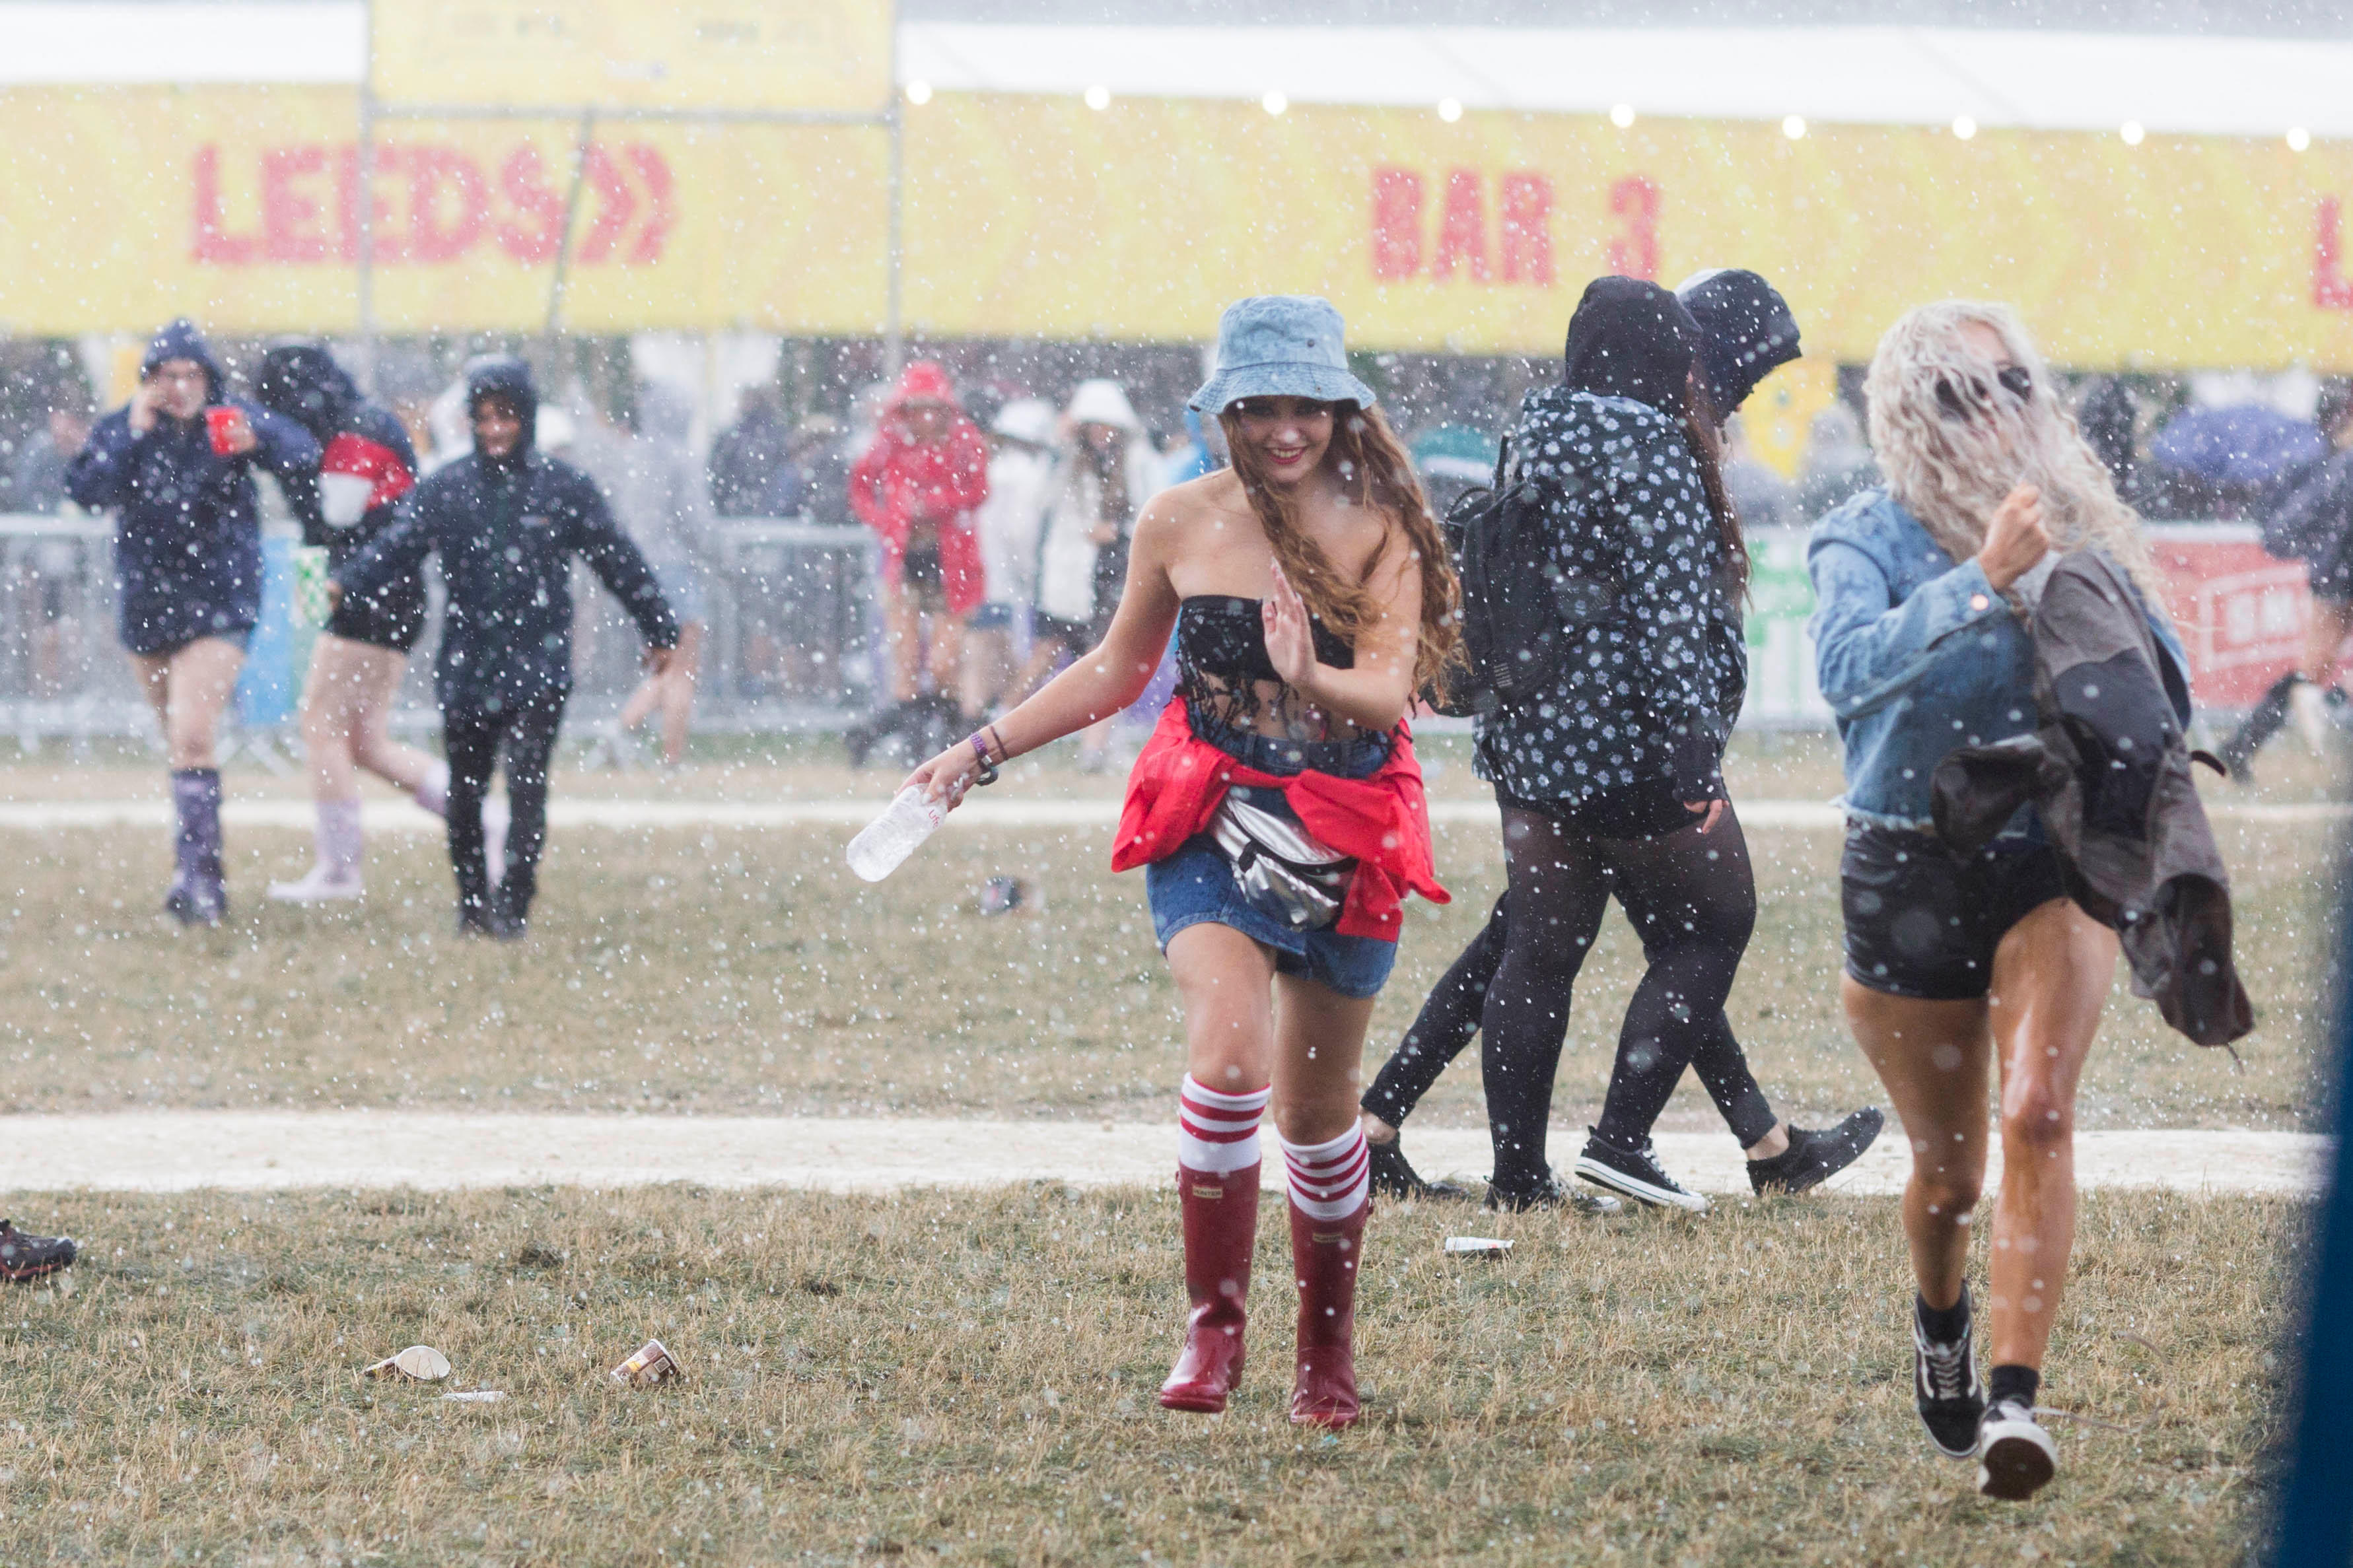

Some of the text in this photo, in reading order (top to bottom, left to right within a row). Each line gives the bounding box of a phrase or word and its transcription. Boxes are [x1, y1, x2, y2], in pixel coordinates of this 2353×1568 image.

[190, 143, 567, 265] LEEDS
[1370, 166, 1662, 285] BAR 3
